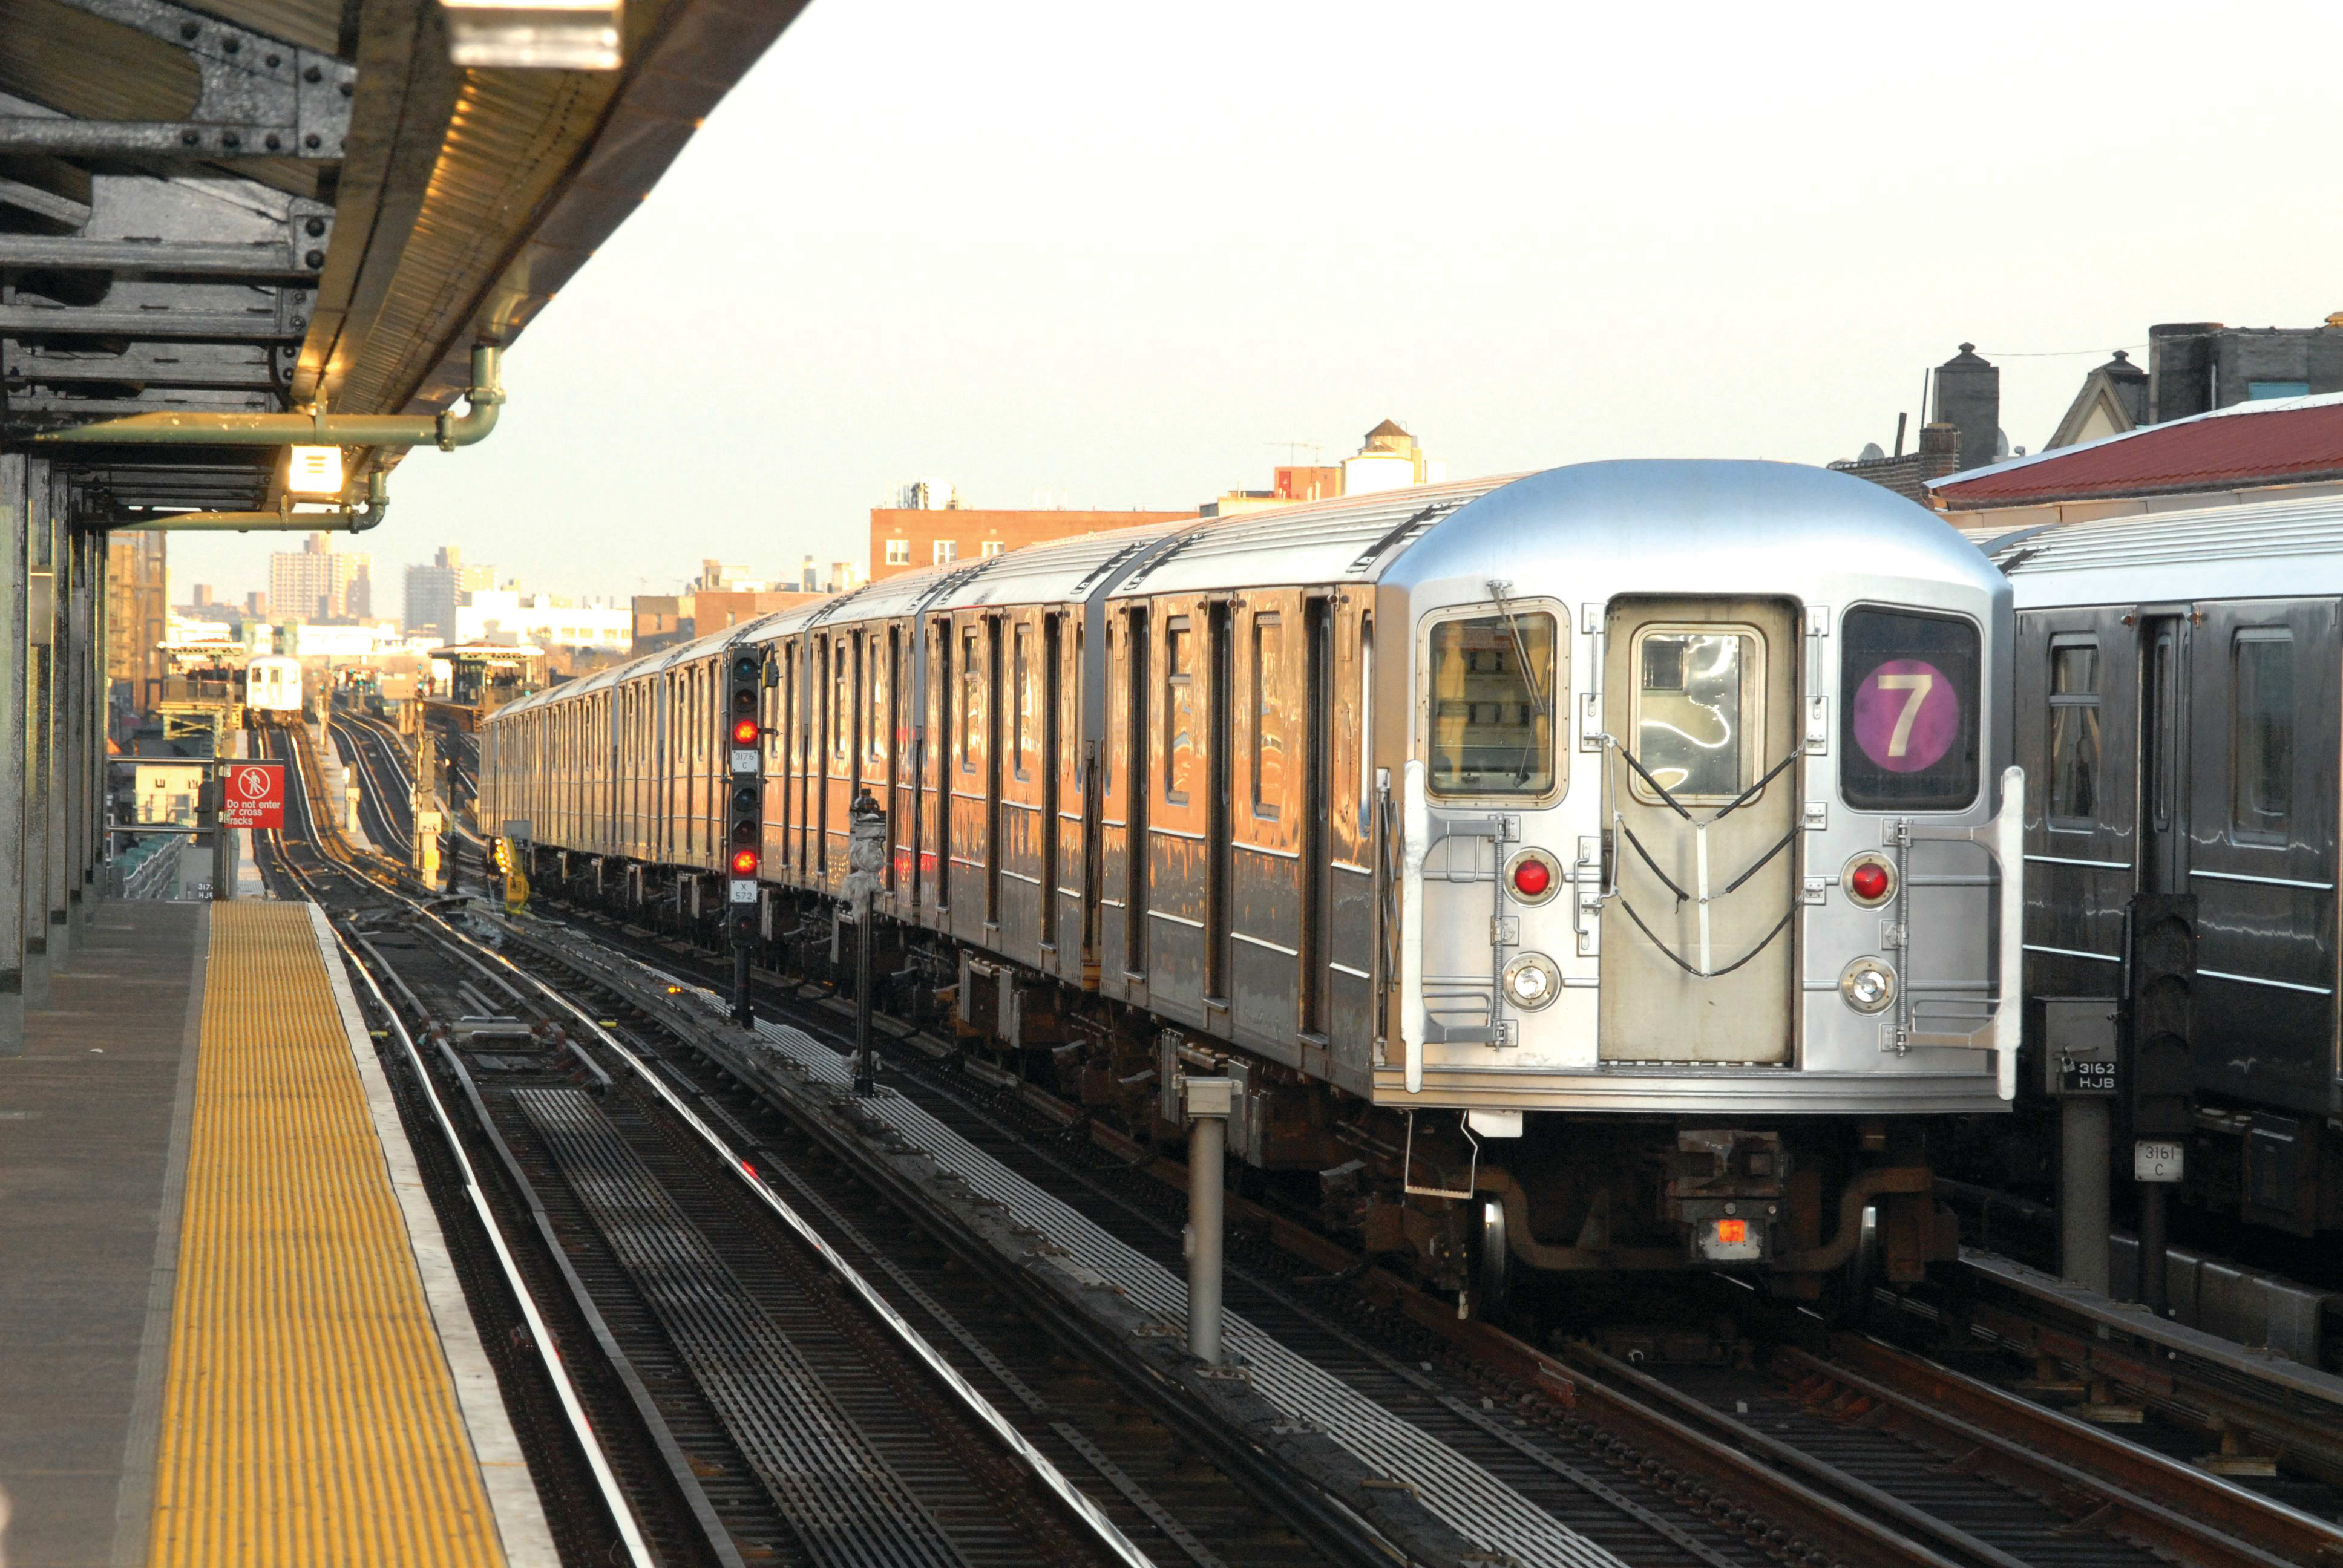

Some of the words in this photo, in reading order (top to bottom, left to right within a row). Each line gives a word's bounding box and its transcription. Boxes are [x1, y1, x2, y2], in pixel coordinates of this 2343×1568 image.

[1878, 675, 1932, 756] 7
[227, 799, 239, 808] Do
[258, 800, 280, 809] enter
[2079, 1063, 2115, 1074] 3162
[2080, 1077, 2114, 1088] HJB
[2146, 1146, 2174, 1159] 3161
[2155, 1163, 2163, 1176] C
